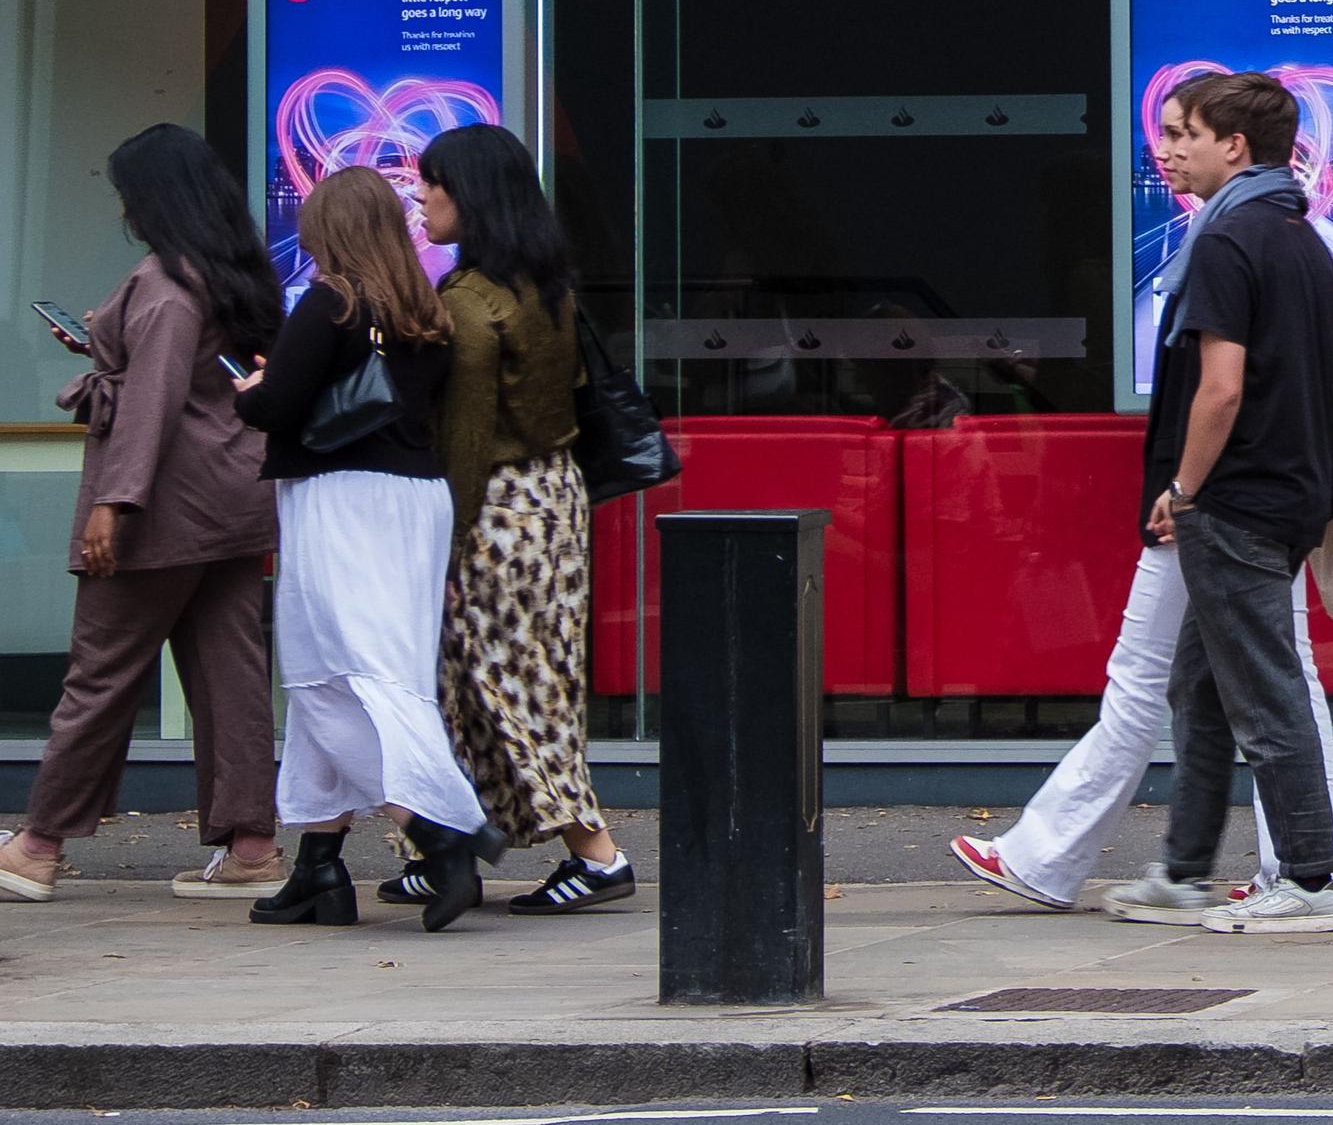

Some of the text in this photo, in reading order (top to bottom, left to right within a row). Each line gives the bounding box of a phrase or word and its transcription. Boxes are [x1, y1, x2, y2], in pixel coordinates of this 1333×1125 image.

[401, 6, 487, 21] goes a long way
[1270, 14, 1300, 24] Thanks
[1301, 14, 1313, 23] for
[401, 31, 430, 39] Thanks
[431, 31, 442, 39] for
[1270, 25, 1332, 37] us with respect
[401, 41, 461, 52] us with respect
